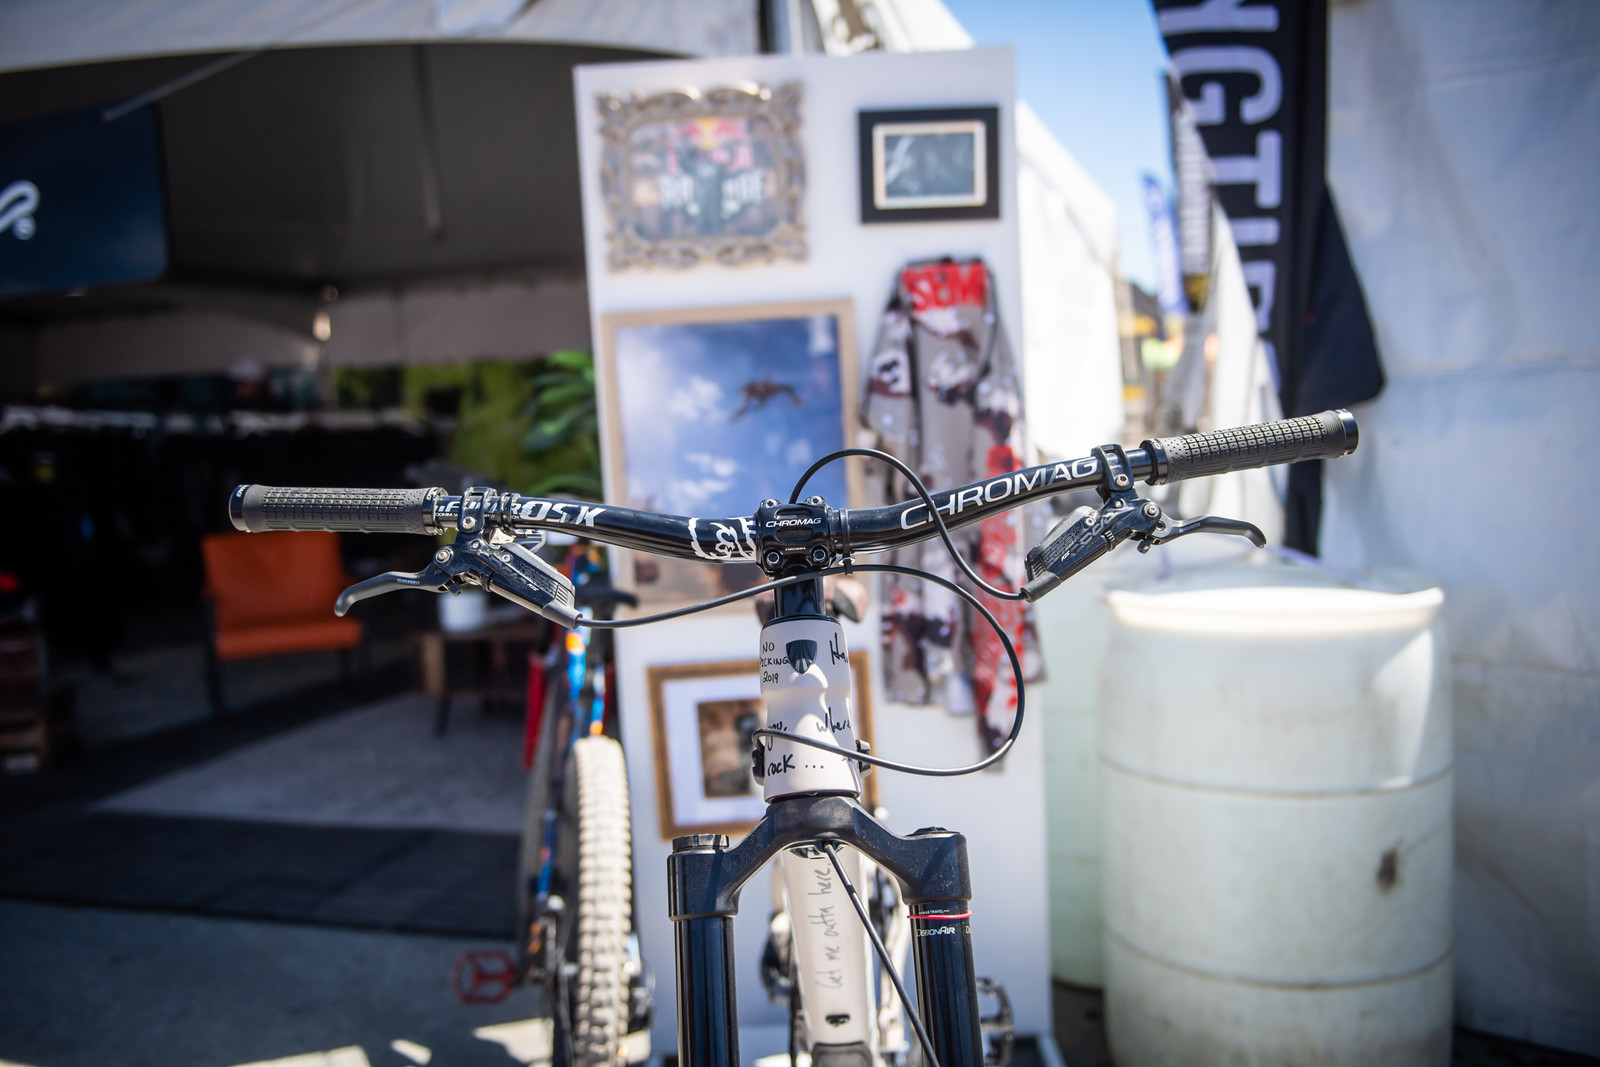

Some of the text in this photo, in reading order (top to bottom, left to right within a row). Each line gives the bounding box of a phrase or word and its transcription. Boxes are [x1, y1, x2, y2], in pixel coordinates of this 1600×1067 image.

[900, 456, 1098, 530] CHROMAG
[765, 517, 823, 528] CHROMAG
[762, 641, 775, 653] NO
[763, 671, 779, 684] 2019
